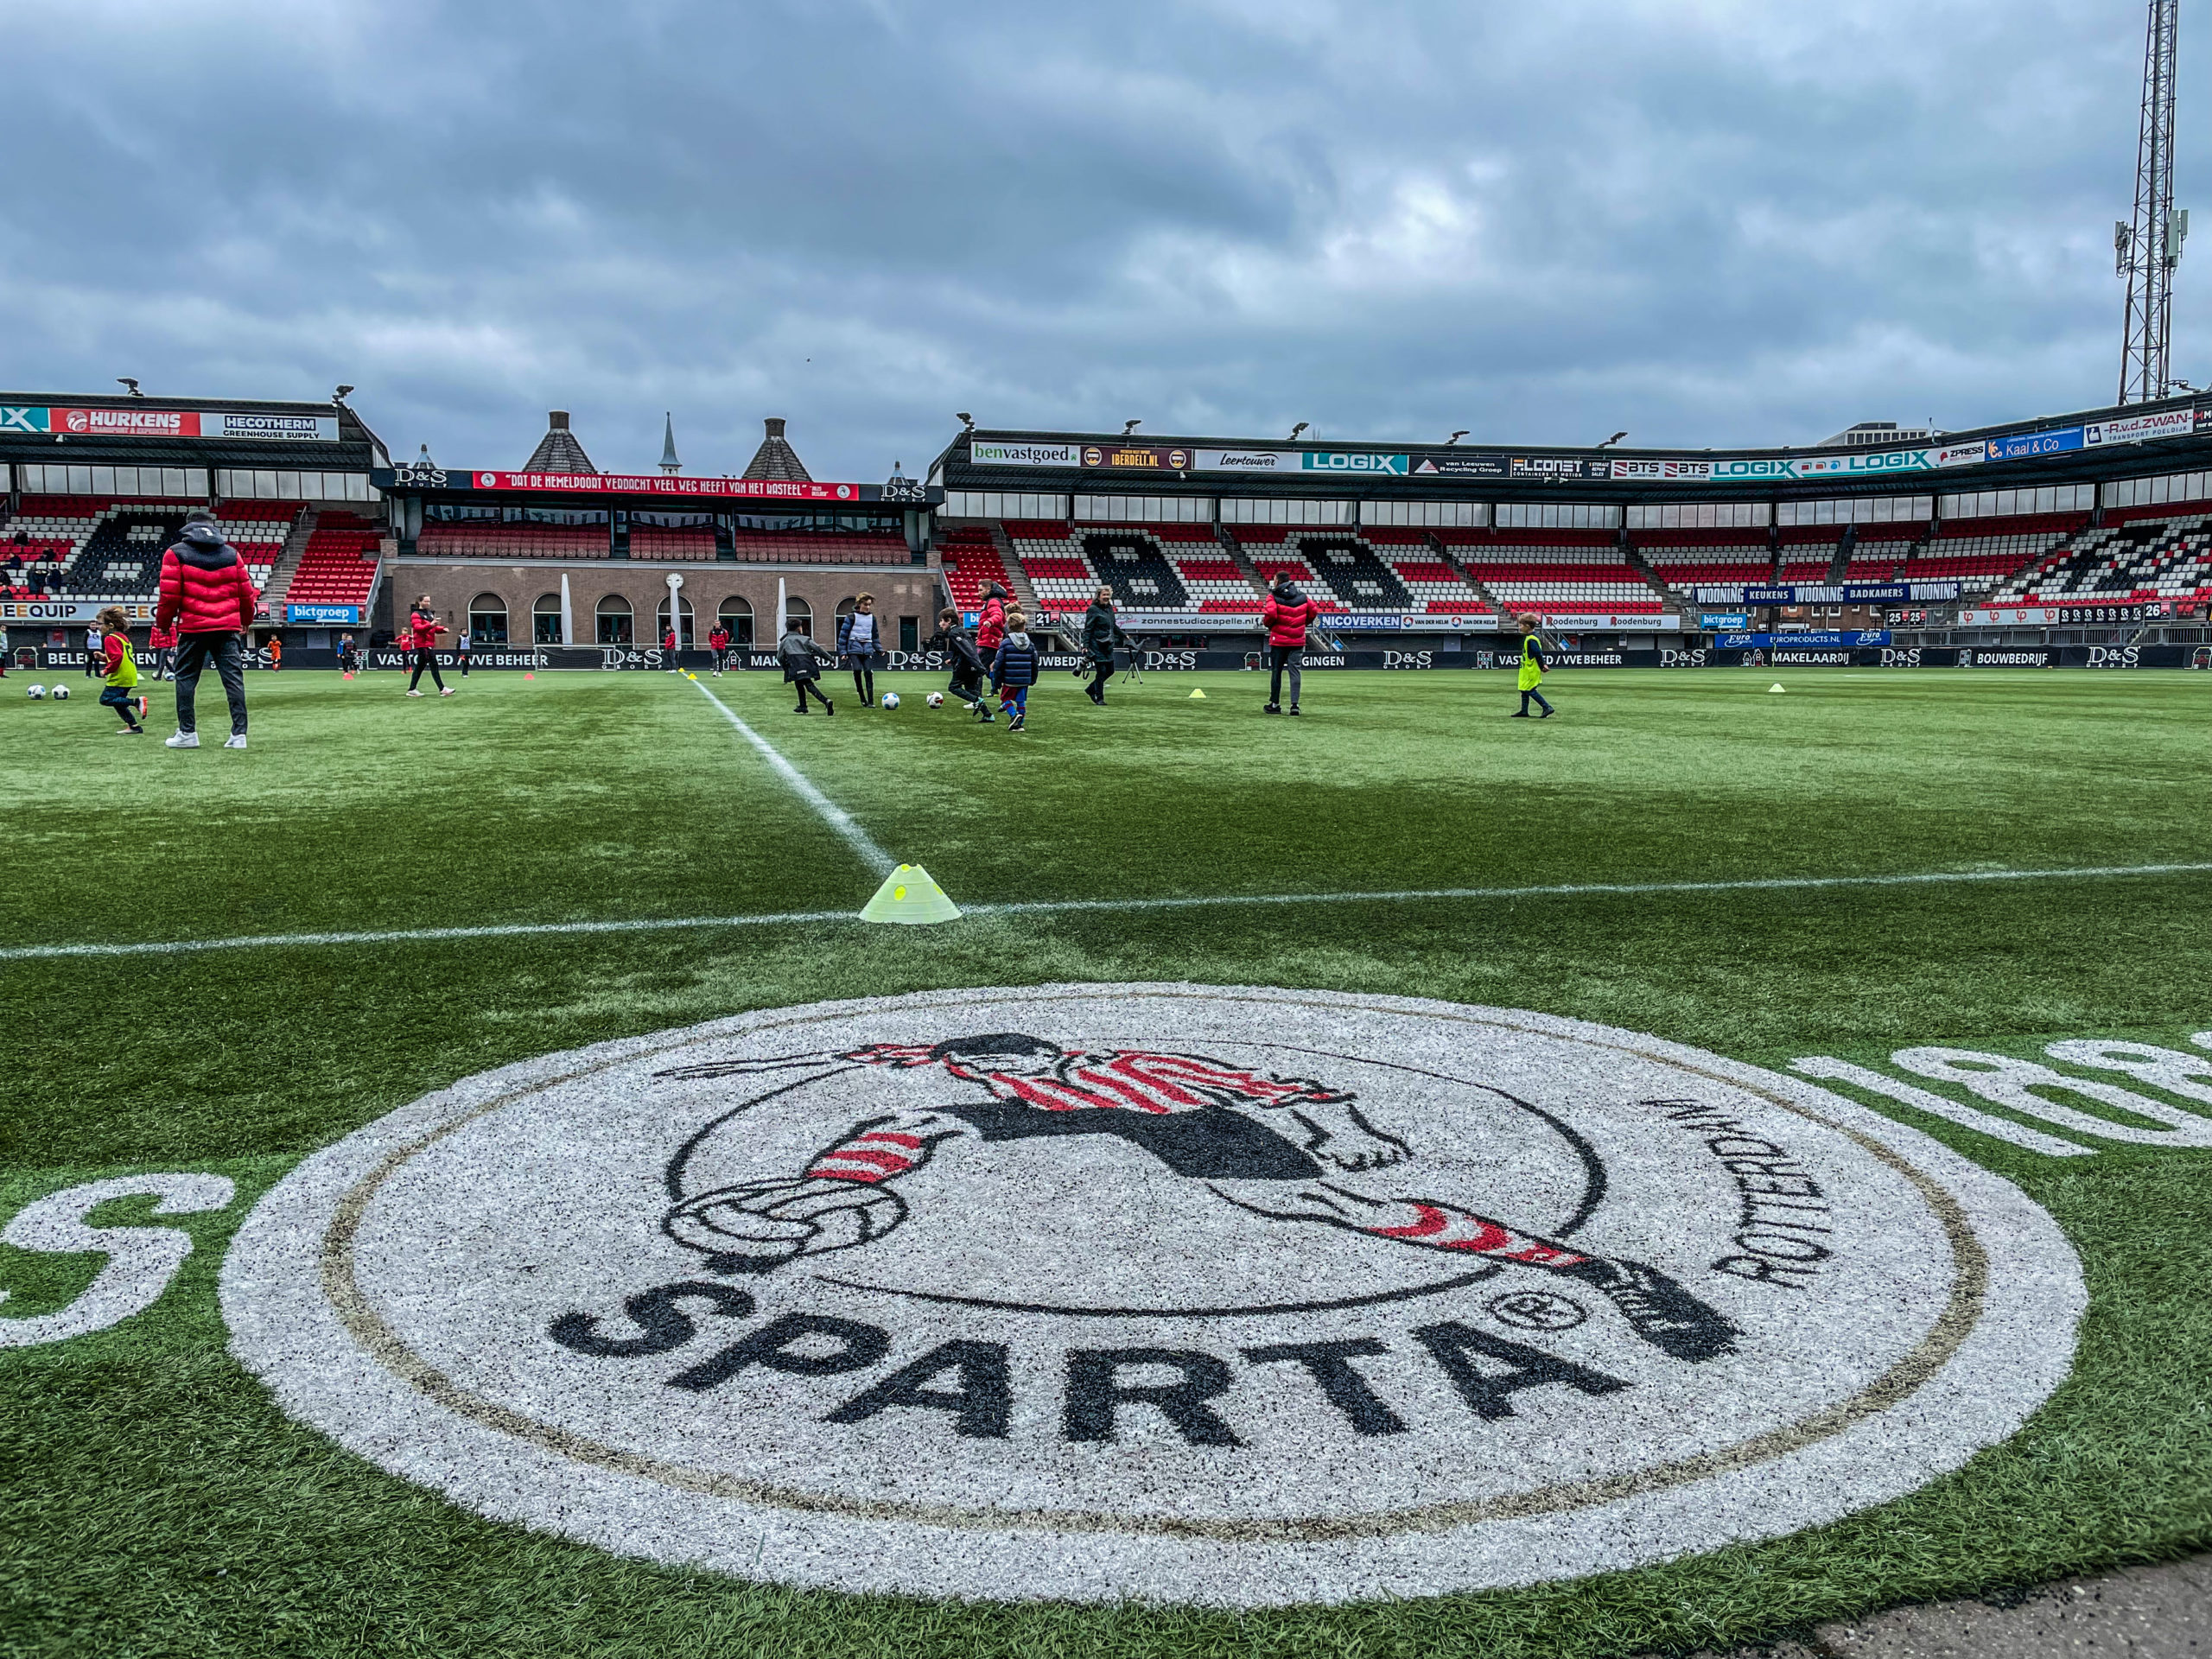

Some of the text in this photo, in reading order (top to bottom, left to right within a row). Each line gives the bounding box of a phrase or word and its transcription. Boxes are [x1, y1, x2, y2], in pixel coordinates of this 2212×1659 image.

[90, 411, 181, 429] HURKENS
[226, 416, 315, 430] HECOTHERM
[223, 429, 284, 439] GREENHOUSE
[2109, 426, 2188, 442] TRANSPORT POELDIJK
[1949, 446, 1984, 457] ZPRESS
[2006, 438, 2059, 456] Kaal & Co
[975, 443, 1069, 466] benvastgoed
[1111, 454, 1159, 467] IBERDELI.NL
[1219, 453, 1276, 467] Leertouwer
[1849, 450, 1933, 470] LOGIX
[1313, 454, 1399, 475] LOGIX
[1629, 462, 1659, 473] BTS
[1679, 463, 1709, 474] BTS
[1714, 461, 1797, 478] LOGIX
[395, 468, 447, 483] D&S
[531, 476, 543, 487] DE
[545, 476, 601, 489] HEMELPOORT
[605, 478, 651, 491] VERDACHT
[654, 480, 676, 492] VEEL
[678, 480, 697, 493] WEG
[701, 481, 726, 493] HEEFT
[729, 482, 746, 494] VAN
[748, 483, 764, 494] HET
[880, 485, 925, 499] D&S
[1697, 583, 1958, 603] WOONING KEUKENS WOONING BADKAMERS WOONING
[295, 606, 350, 620] bictgroep
[1889, 613, 1901, 622] 25
[1910, 612, 1920, 622] 25
[2145, 605, 2160, 617] 26
[1036, 613, 1049, 624] 21
[1141, 617, 1254, 626] zonnestudiocapelle.nl
[1322, 615, 1400, 626] NICOVERKEN
[1546, 616, 1598, 627] Roodenburg
[1610, 616, 1662, 627] Roodenburg
[1704, 614, 1743, 626] bictgroep
[497, 654, 548, 666] BEHEER
[601, 649, 664, 665] D&S
[887, 650, 944, 665] D&S
[1145, 651, 1197, 665] D&S
[1383, 651, 1433, 665] D&S
[1555, 655, 1560, 664] /
[1563, 655, 1582, 664] VVE
[1584, 654, 1622, 664] BEHEER
[1661, 649, 1707, 663] D&S
[1771, 652, 1850, 664] MAKELAARDIJ
[1880, 648, 1921, 664] D&S
[1977, 652, 2049, 666] BOUWBEDRIJF
[2088, 646, 2140, 664] D&S
[1640, 1098, 1832, 1289] ROTTERDAM
[548, 1281, 1630, 1449] SPARTA
